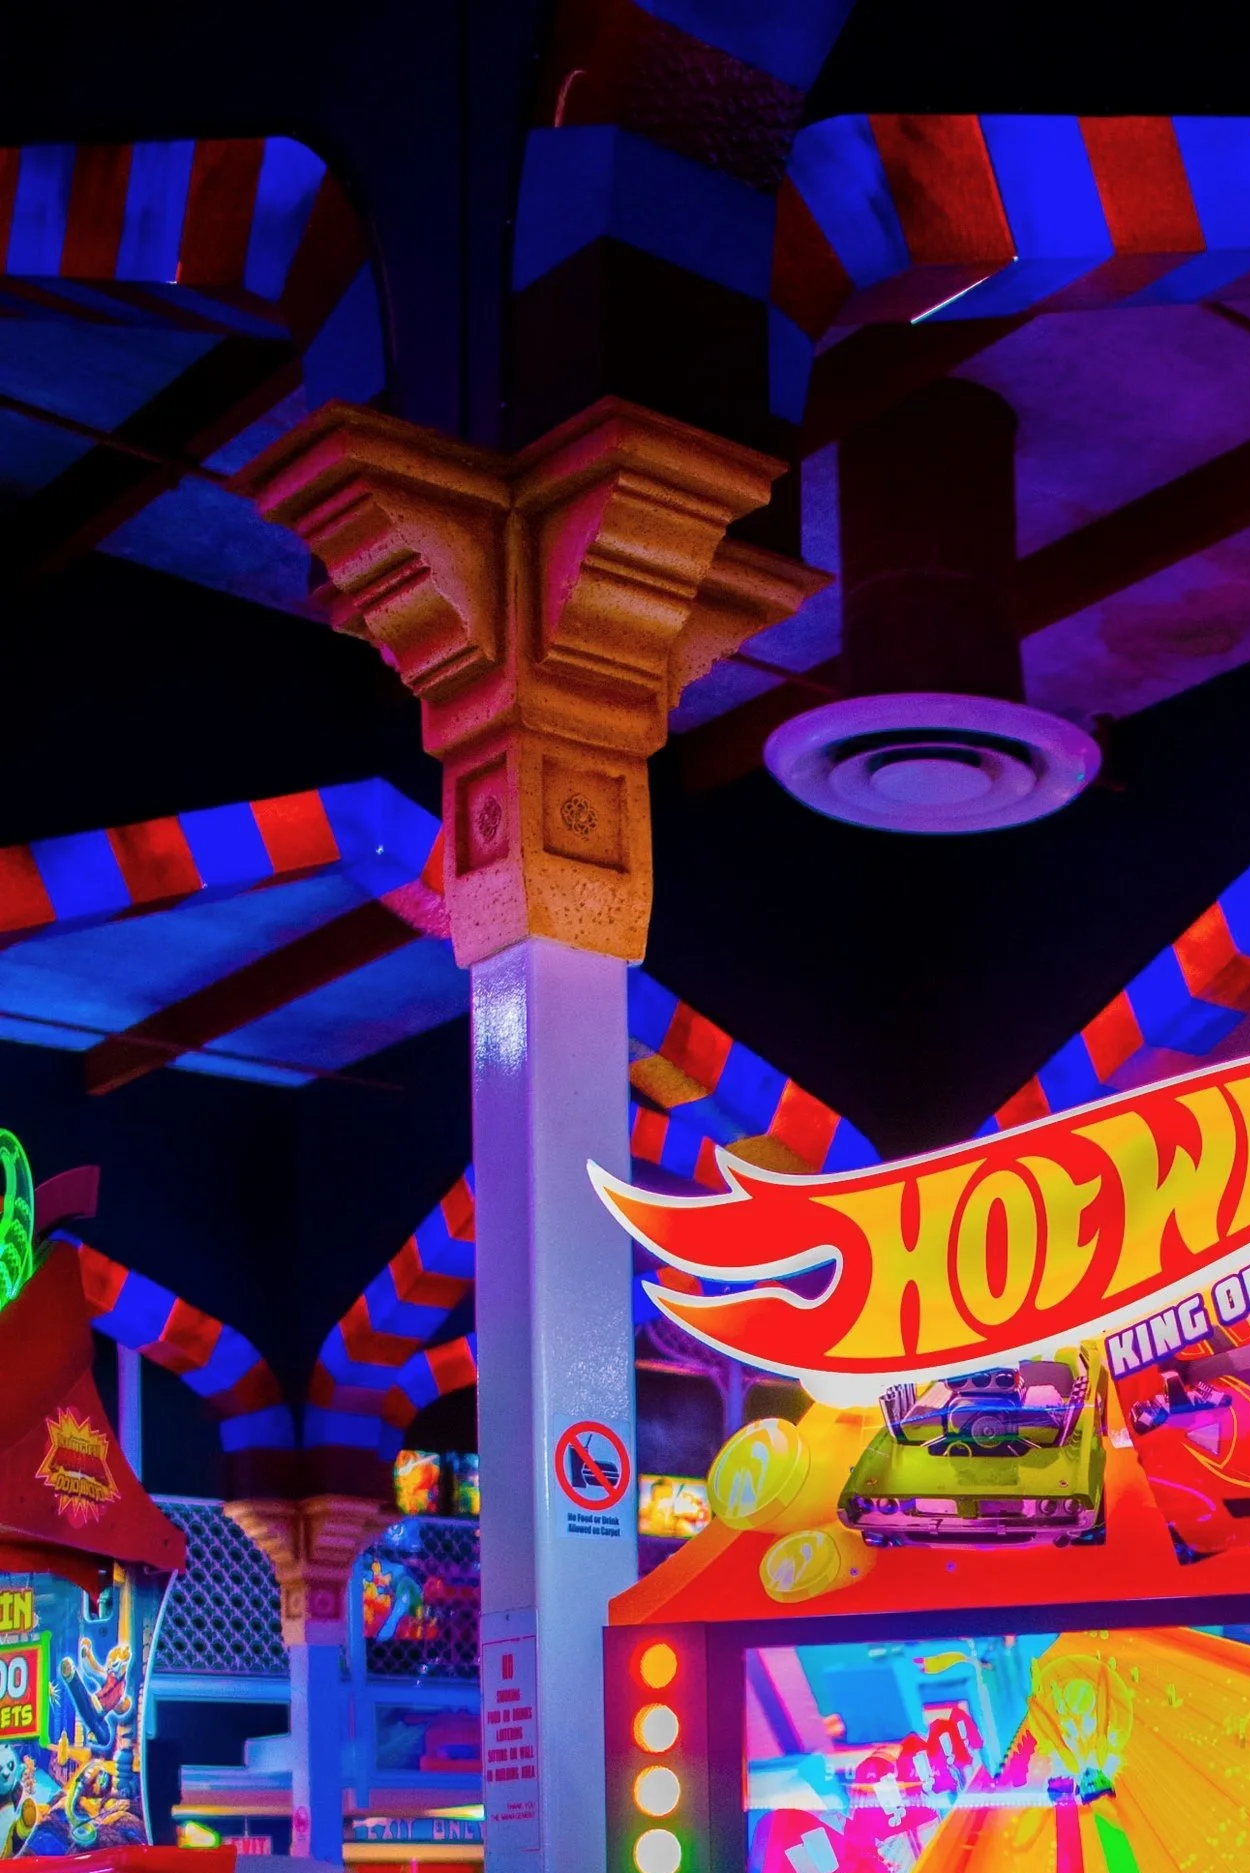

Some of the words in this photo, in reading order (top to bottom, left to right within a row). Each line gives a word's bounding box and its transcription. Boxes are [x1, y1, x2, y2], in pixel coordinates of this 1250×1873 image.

[810, 1155, 1103, 1360] HOT
[1106, 1303, 1208, 1377] KING
[567, 1513, 577, 1522] No
[577, 1514, 593, 1523] Food
[594, 1516, 601, 1524] or
[601, 1515, 620, 1526] Drink
[567, 1524, 592, 1535] Allowed
[592, 1526, 600, 1535] on
[601, 1527, 621, 1537] Carpet
